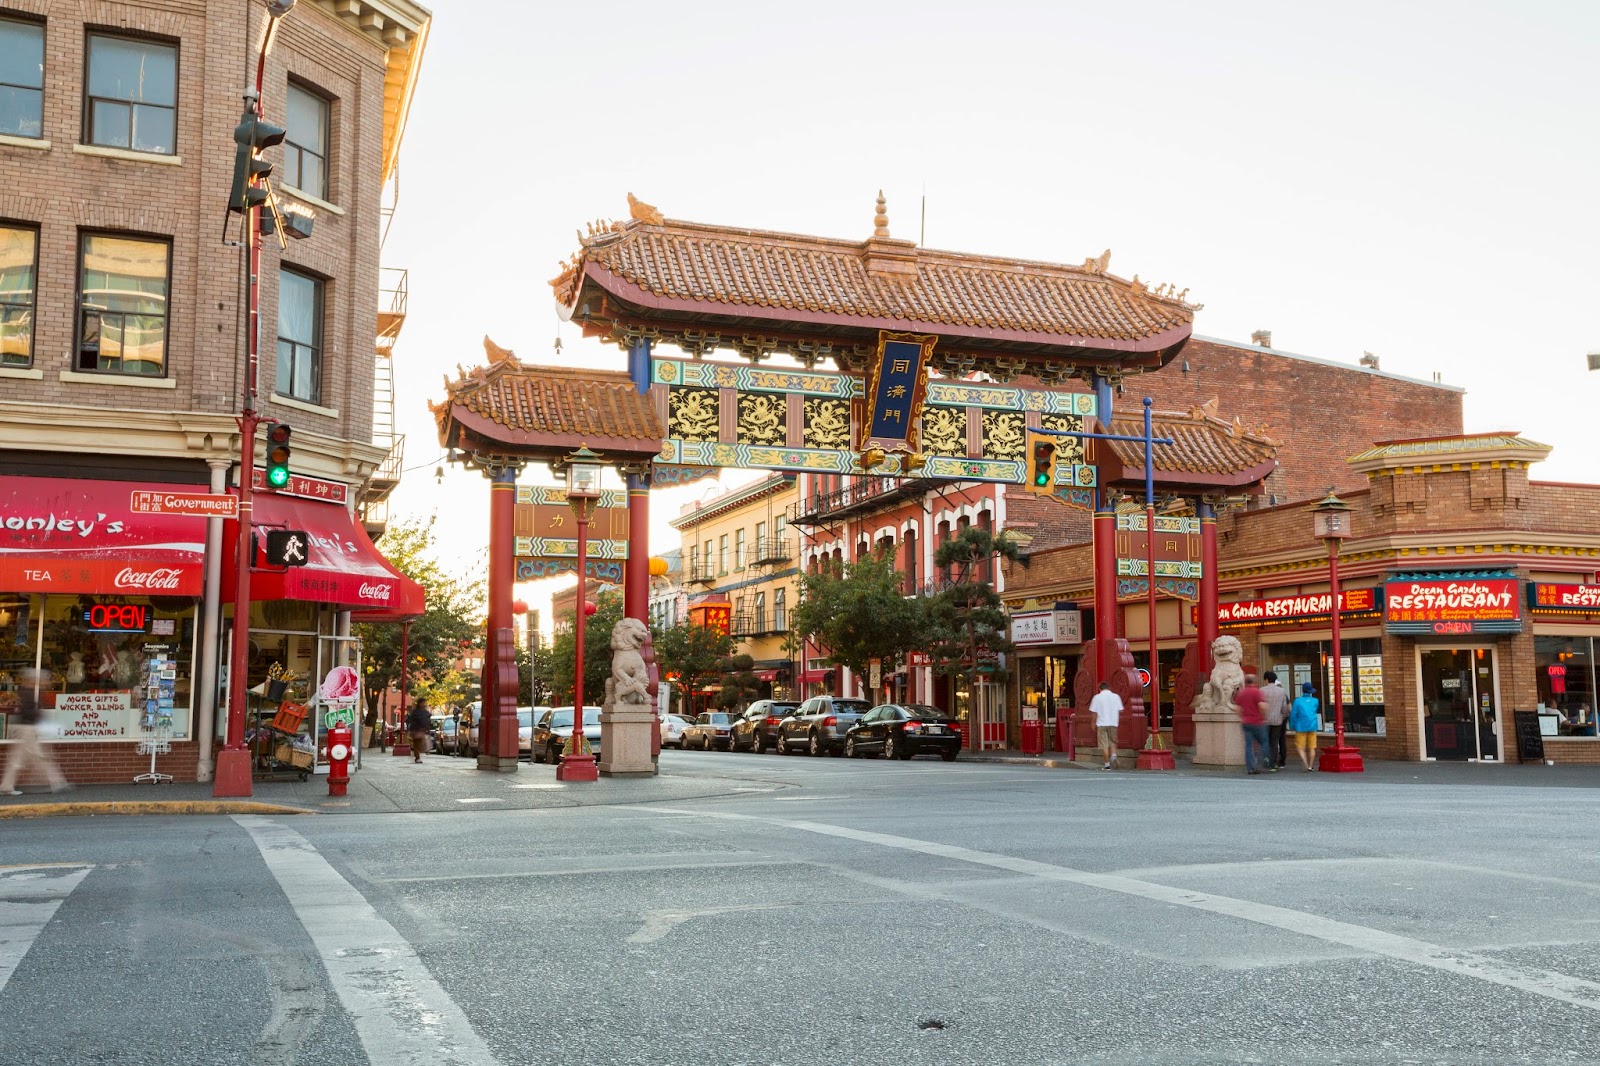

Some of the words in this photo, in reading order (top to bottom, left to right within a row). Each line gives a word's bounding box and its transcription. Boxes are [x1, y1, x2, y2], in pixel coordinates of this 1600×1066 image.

[164, 495, 234, 510] Government
[0, 512, 124, 537] onley's
[24, 569, 52, 581] TEA
[114, 567, 184, 588] Coca-Cola
[358, 581, 392, 600] Coca-Cola
[1411, 584, 1443, 595] Ocean
[1447, 583, 1489, 594] Garden
[1389, 592, 1512, 609] RESTAURANT
[91, 604, 145, 629] OPEN
[1232, 602, 1263, 619] Garden
[1434, 622, 1472, 633] OPEN
[1548, 665, 1566, 675] OPEN
[66, 695, 92, 703] MORE
[94, 695, 119, 703] GIFTS
[96, 703, 125, 711] BLINDS
[82, 712, 99, 720] AND
[75, 720, 108, 728] RATTAN
[64, 729, 117, 737] DOWNSTAIRS
